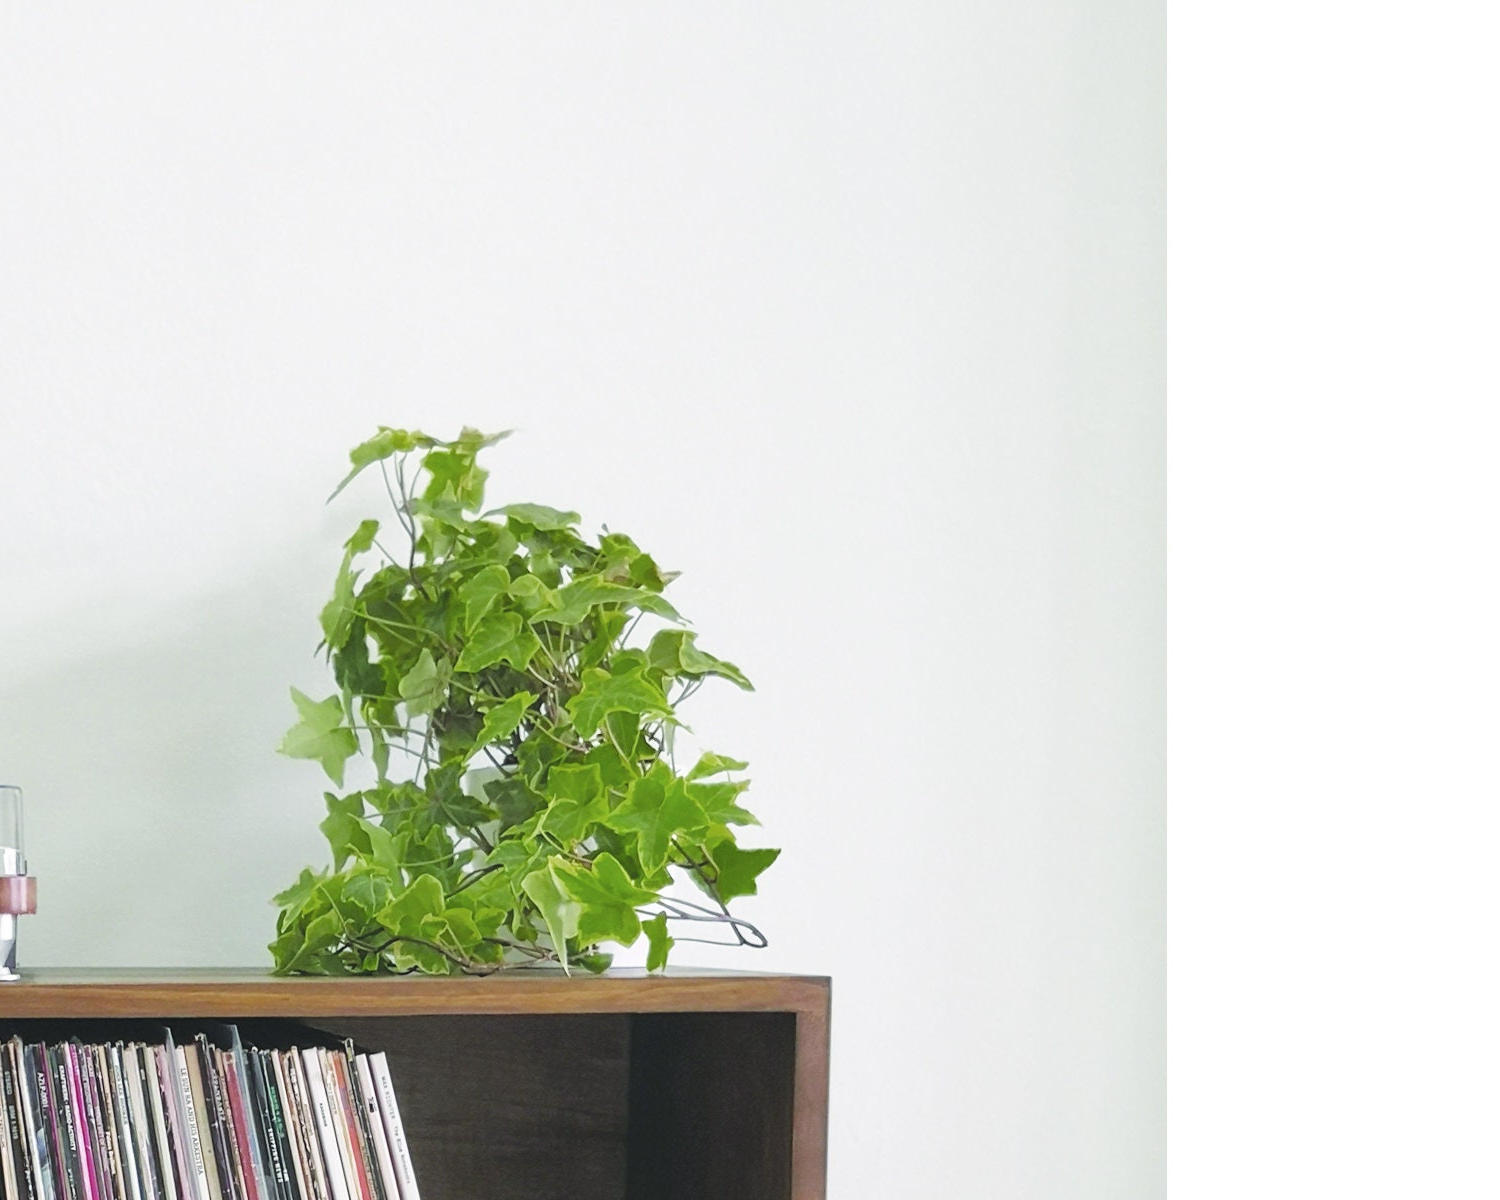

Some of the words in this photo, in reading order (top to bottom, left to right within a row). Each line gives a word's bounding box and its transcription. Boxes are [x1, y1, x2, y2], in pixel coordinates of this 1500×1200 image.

[180, 1077, 190, 1093] SUN
[183, 1094, 192, 1105] RA
[185, 1106, 195, 1122] AND
[188, 1123, 197, 1136] HIS
[392, 1125, 400, 1136] The
[190, 1136, 204, 1175] ARKESTRA
[266, 1127, 279, 1161] SHIPPING
[273, 1162, 284, 1183] NEWS
